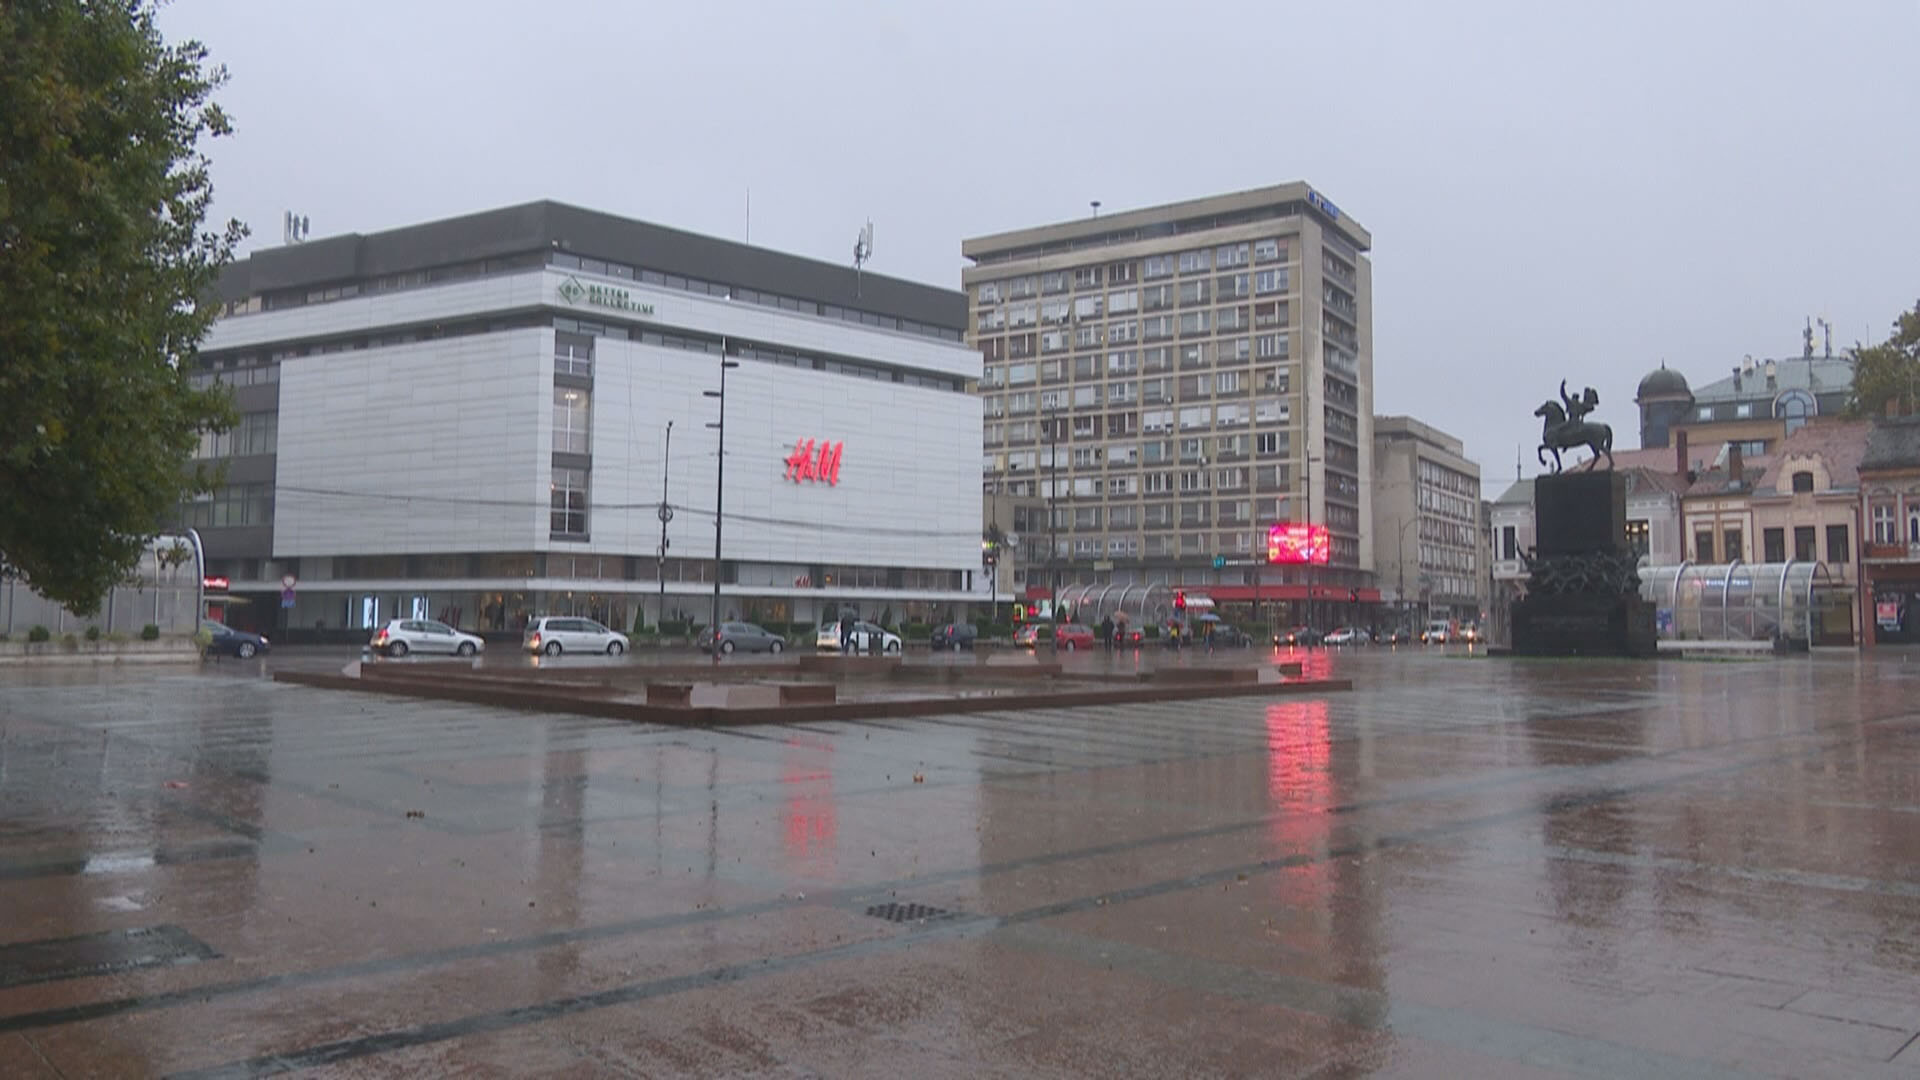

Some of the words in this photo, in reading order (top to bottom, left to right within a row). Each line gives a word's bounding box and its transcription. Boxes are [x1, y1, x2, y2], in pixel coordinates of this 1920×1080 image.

[589, 285, 629, 298] BETTER
[589, 296, 654, 314] COLLECTIVE
[785, 437, 843, 487] H&M
